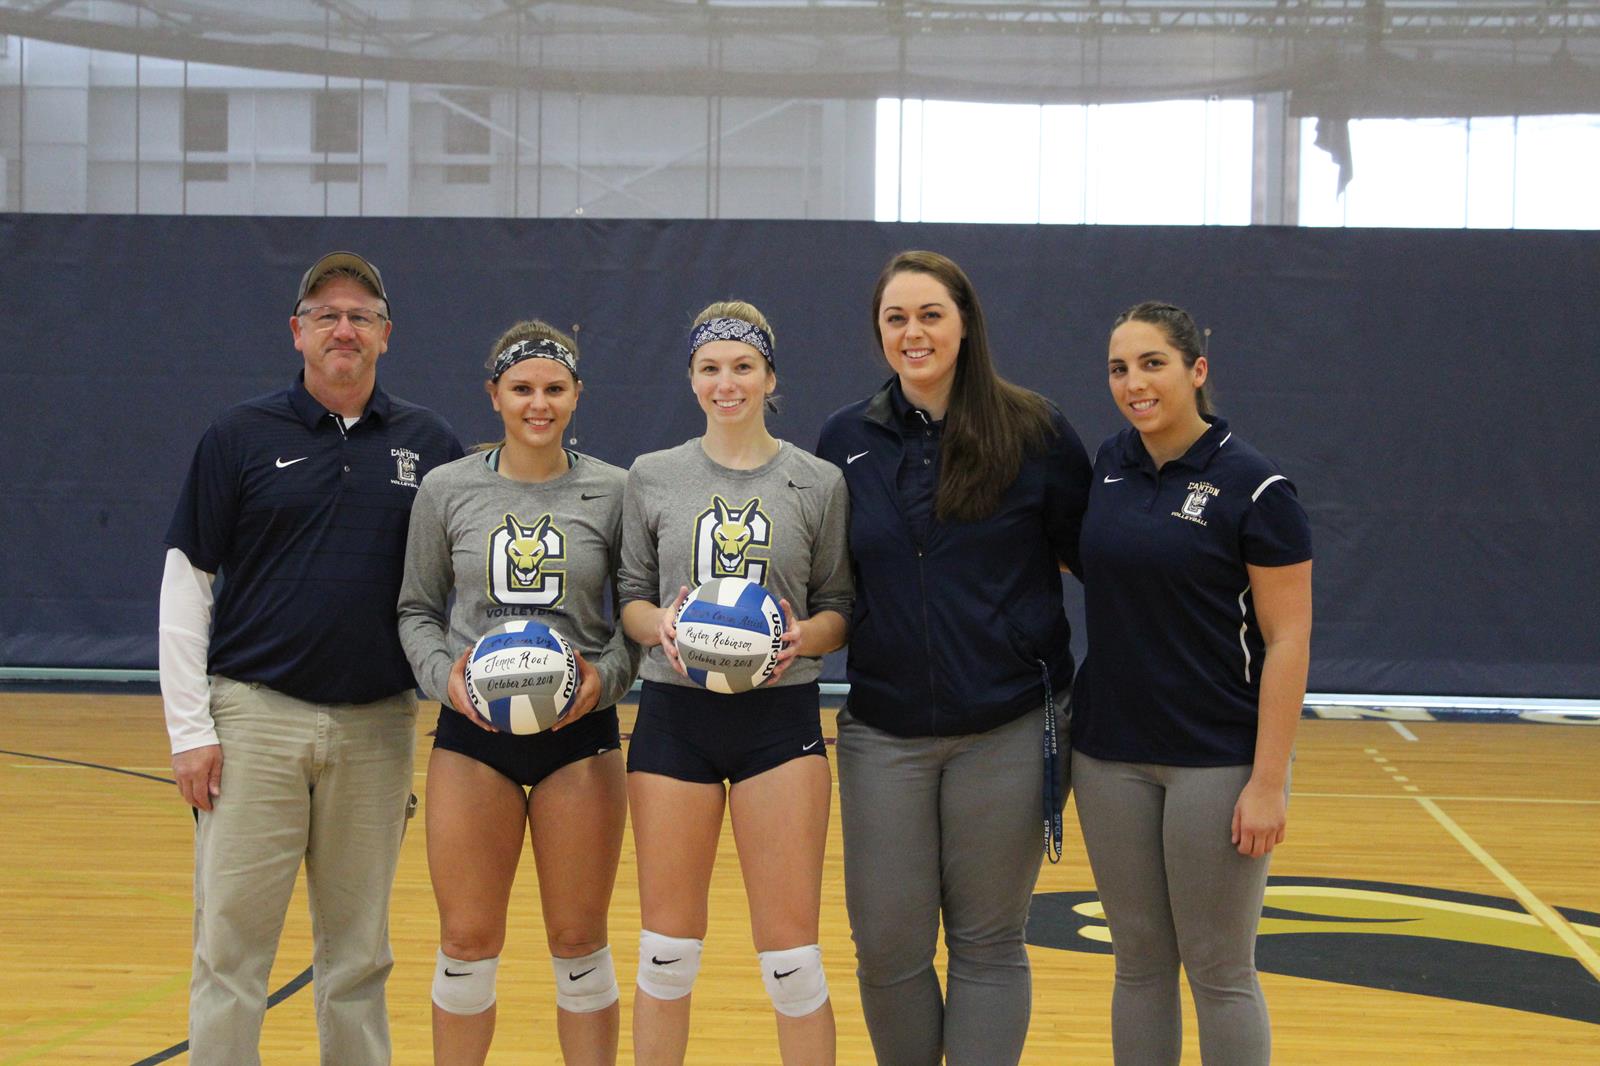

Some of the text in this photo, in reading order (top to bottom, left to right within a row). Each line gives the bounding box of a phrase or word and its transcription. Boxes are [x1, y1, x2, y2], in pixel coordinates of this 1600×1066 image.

[391, 449, 420, 461] CANTON
[1187, 482, 1220, 497] CANTON
[686, 627, 752, 651] Peyton Robinson
[762, 613, 782, 677] molten
[485, 655, 516, 673] Jenna
[688, 650, 716, 666] October
[487, 679, 519, 691] October
[536, 675, 554, 686] 2018
